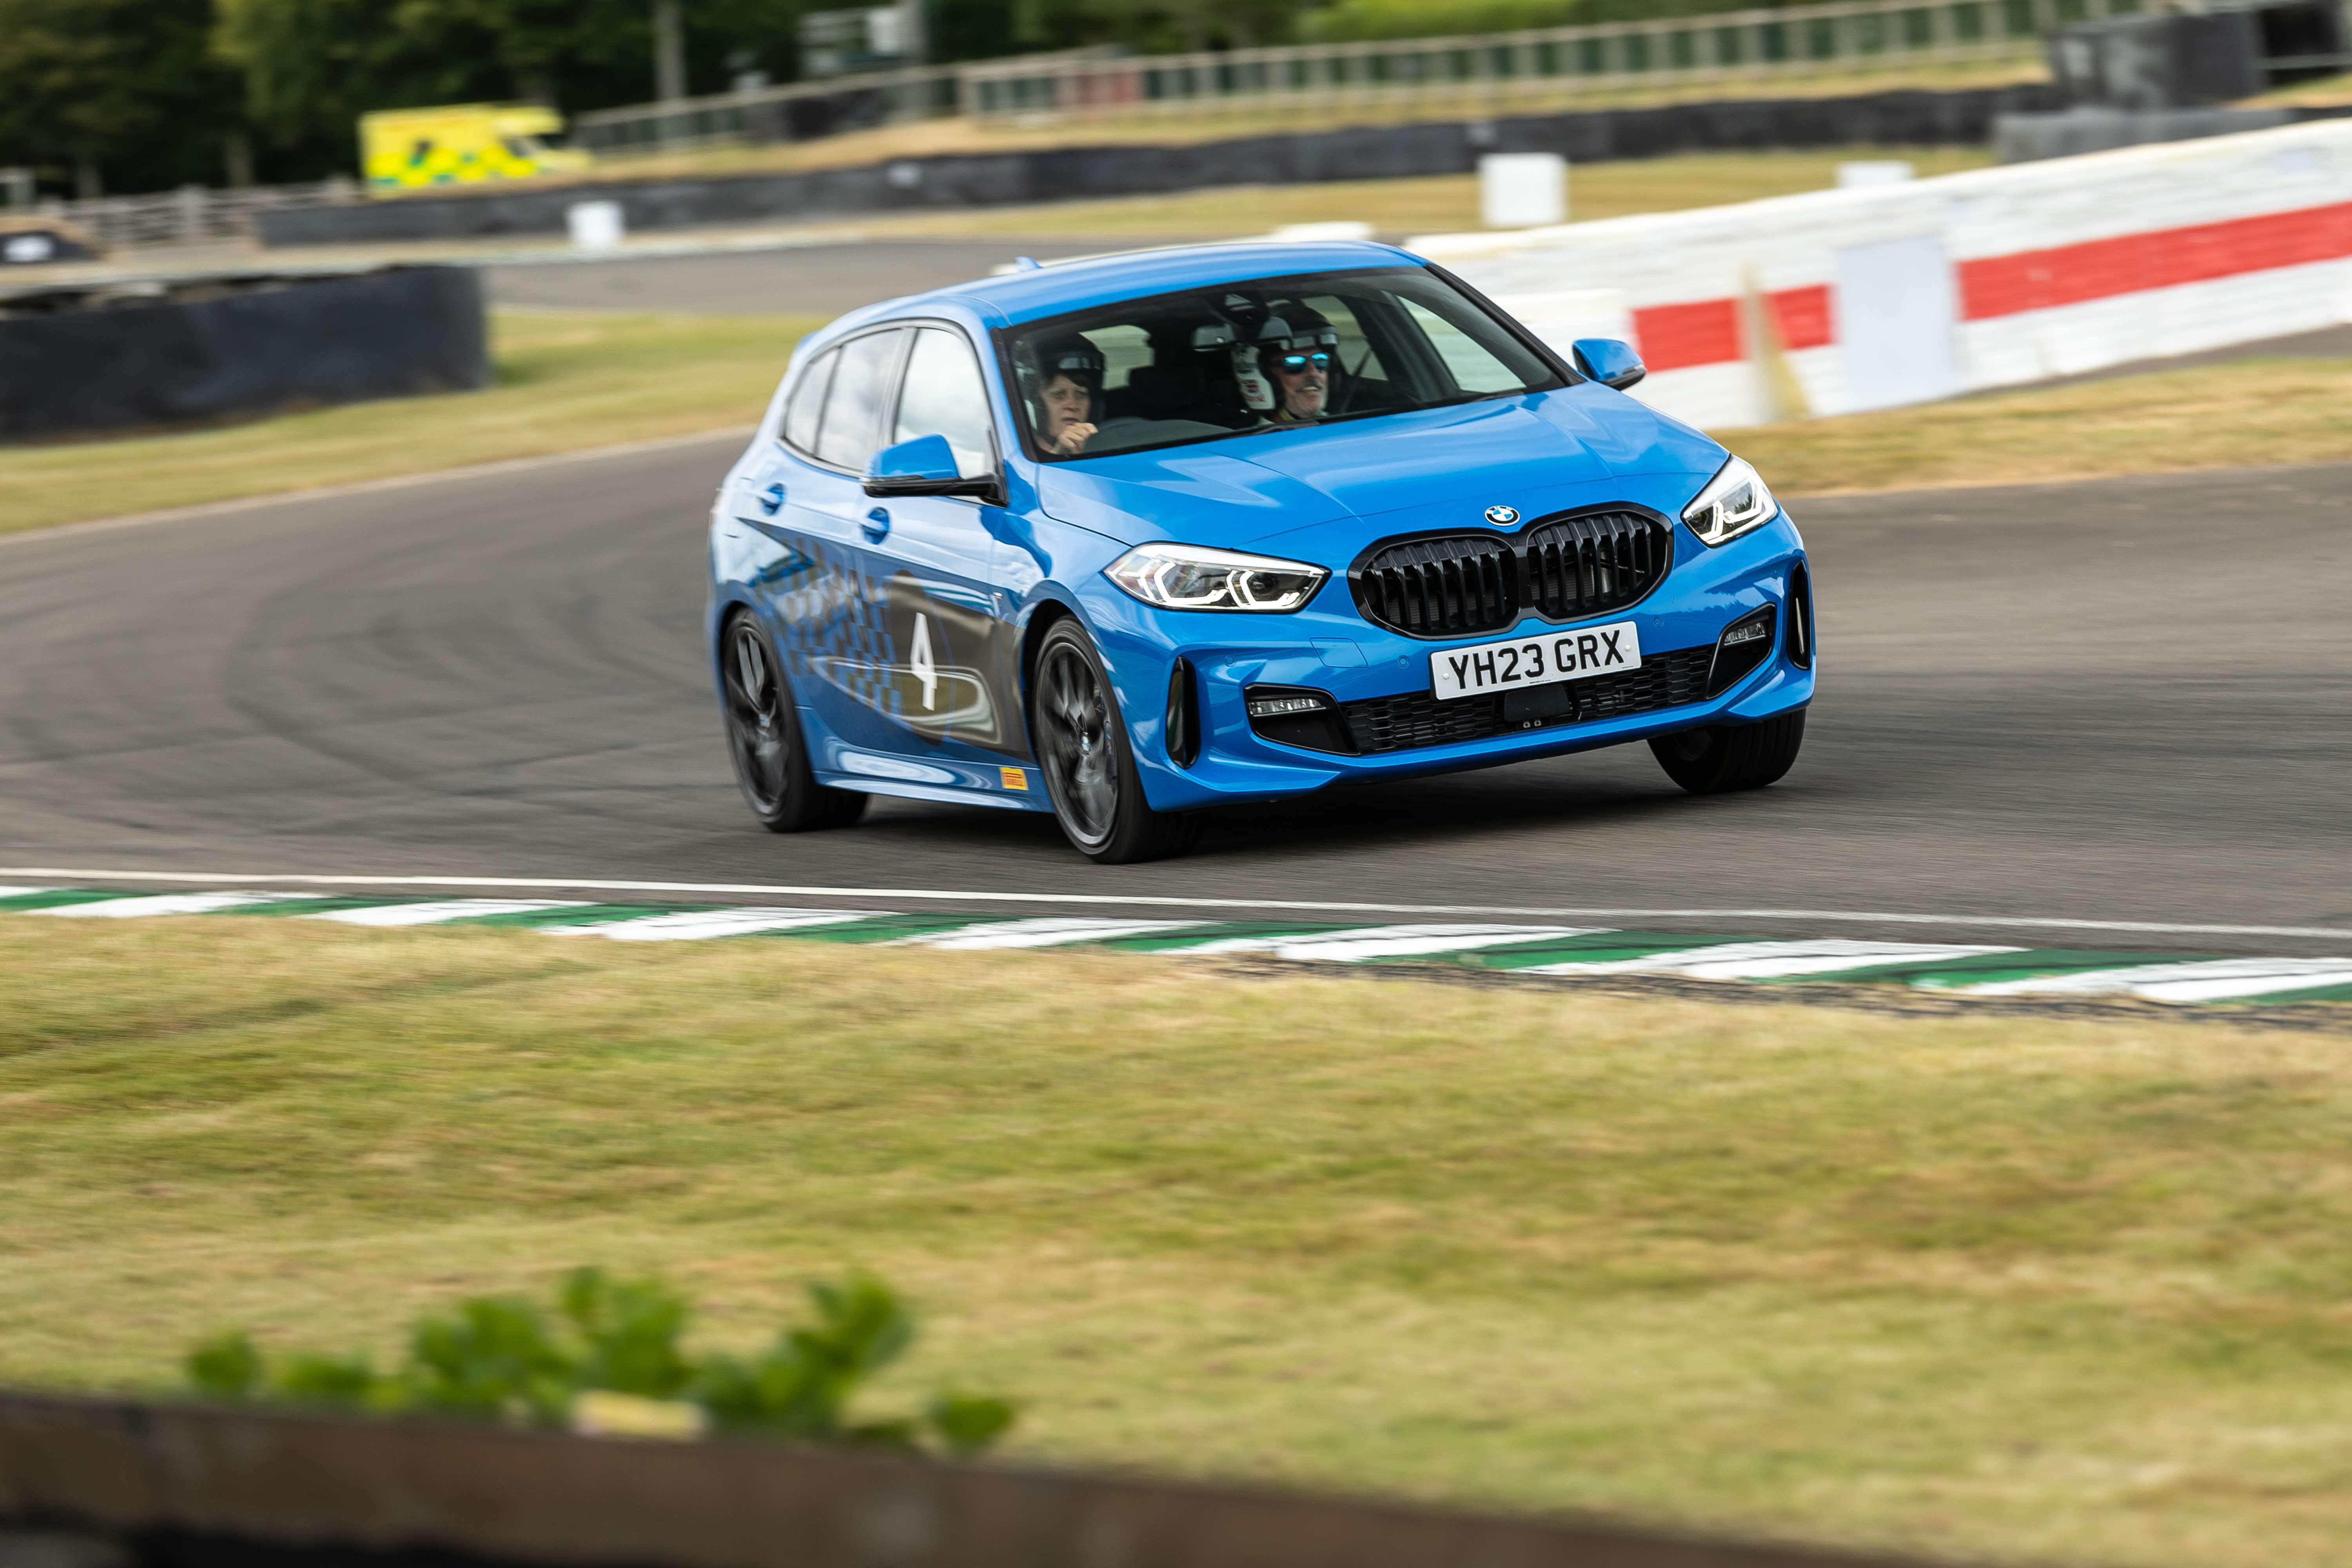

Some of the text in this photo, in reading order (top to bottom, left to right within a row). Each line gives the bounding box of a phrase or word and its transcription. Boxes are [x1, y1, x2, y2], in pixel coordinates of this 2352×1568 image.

[910, 612, 937, 711] 4
[1448, 630, 1624, 689] YH23 GRX
